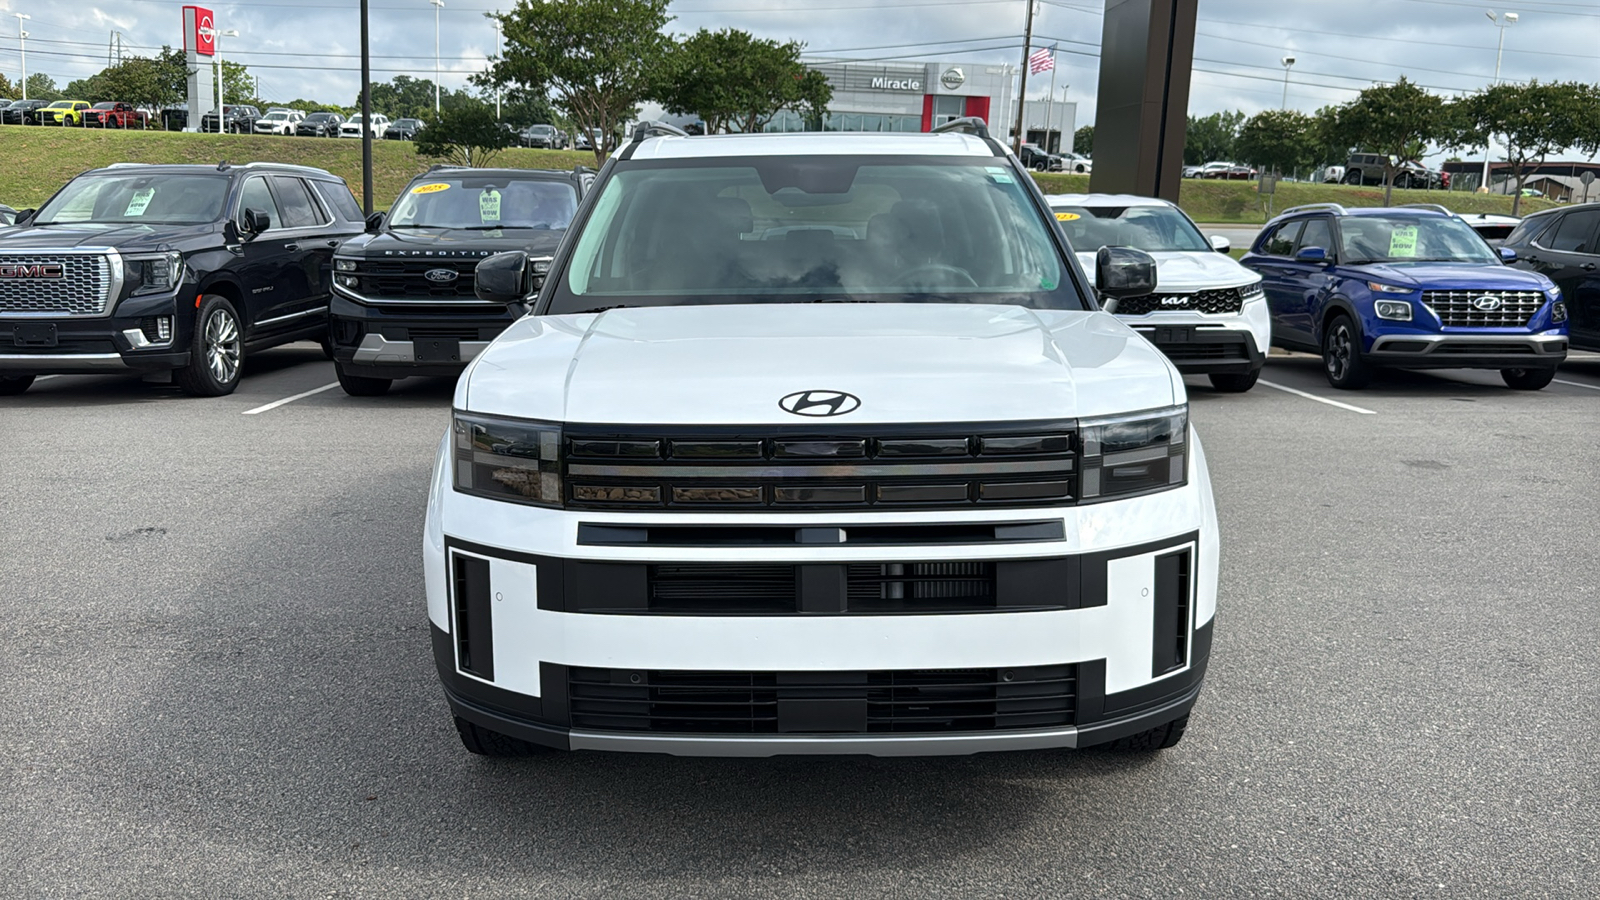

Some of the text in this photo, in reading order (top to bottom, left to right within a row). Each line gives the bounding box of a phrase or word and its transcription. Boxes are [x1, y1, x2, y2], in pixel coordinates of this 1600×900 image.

[871, 77, 920, 90] Miracle
[0, 264, 62, 278] GMC
[430, 271, 452, 280] Ford
